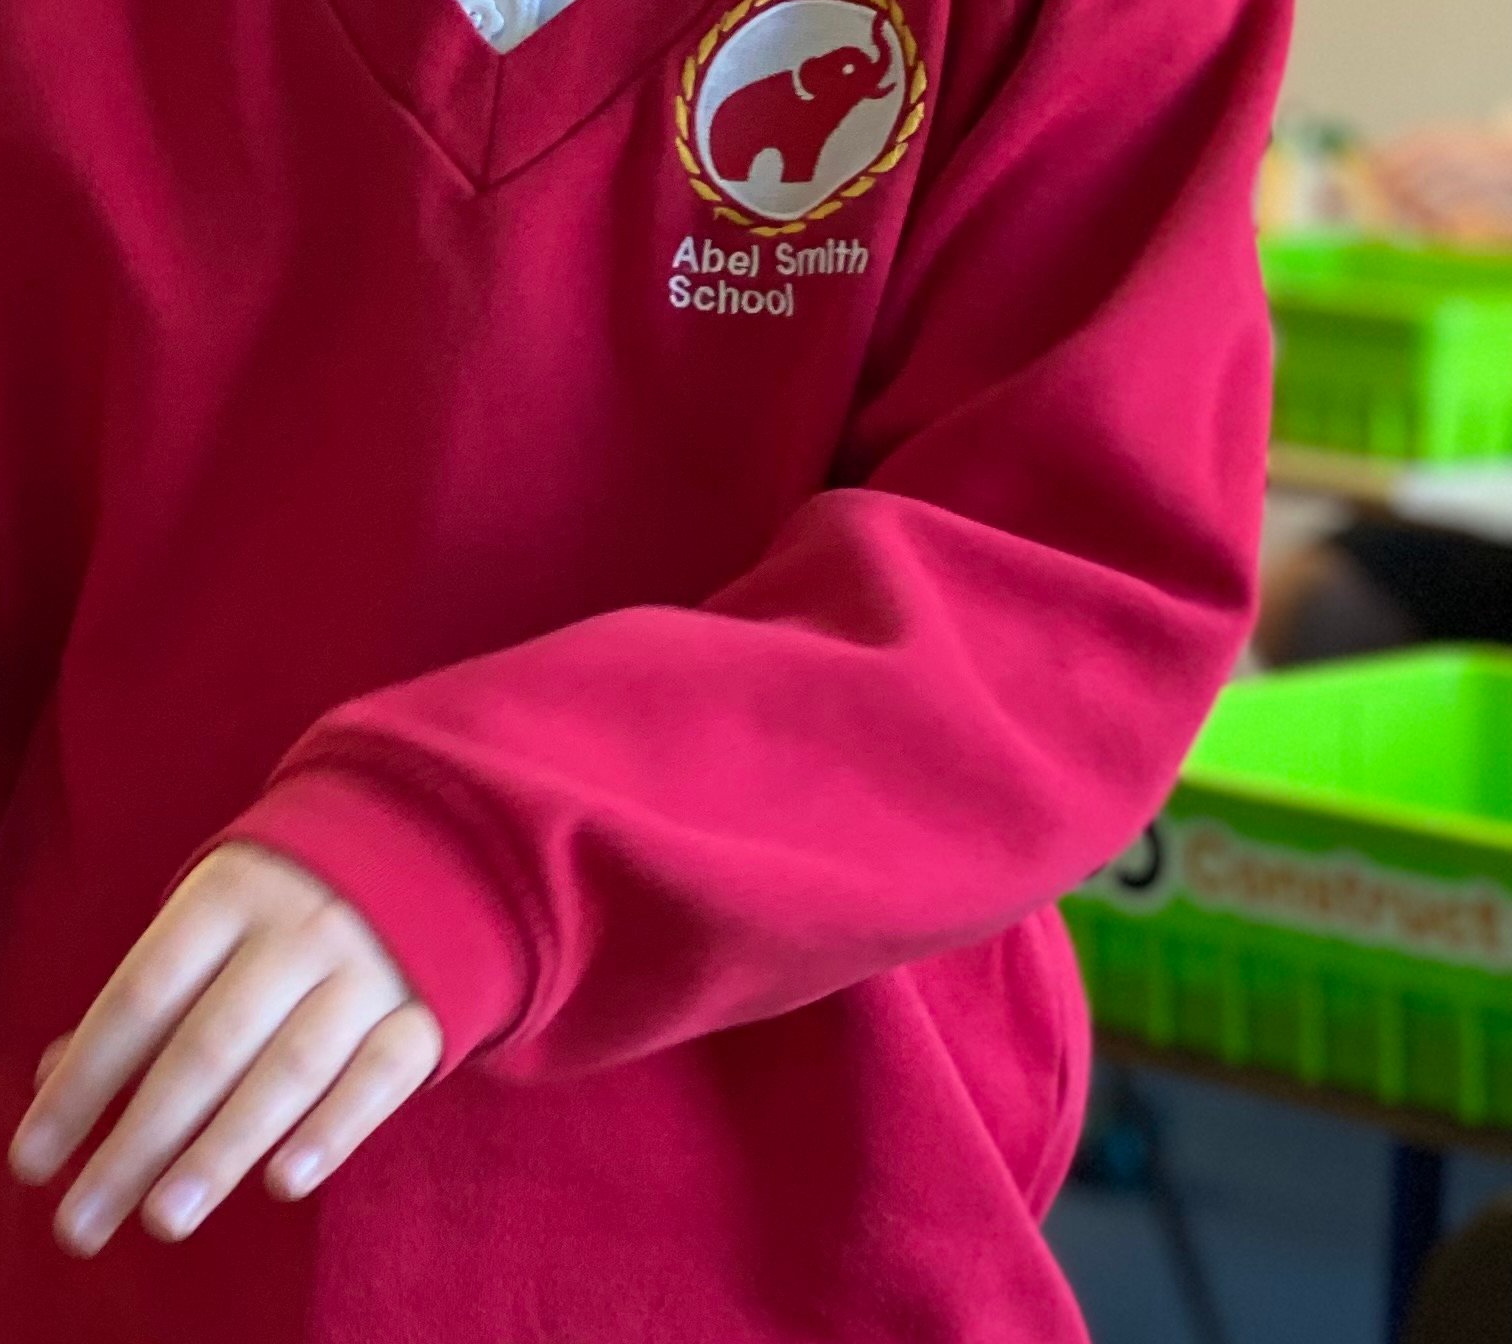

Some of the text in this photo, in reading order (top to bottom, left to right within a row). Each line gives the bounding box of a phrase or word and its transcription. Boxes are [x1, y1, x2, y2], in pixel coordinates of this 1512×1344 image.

[672, 236, 869, 277] Abel Smith
[668, 274, 795, 316] School
